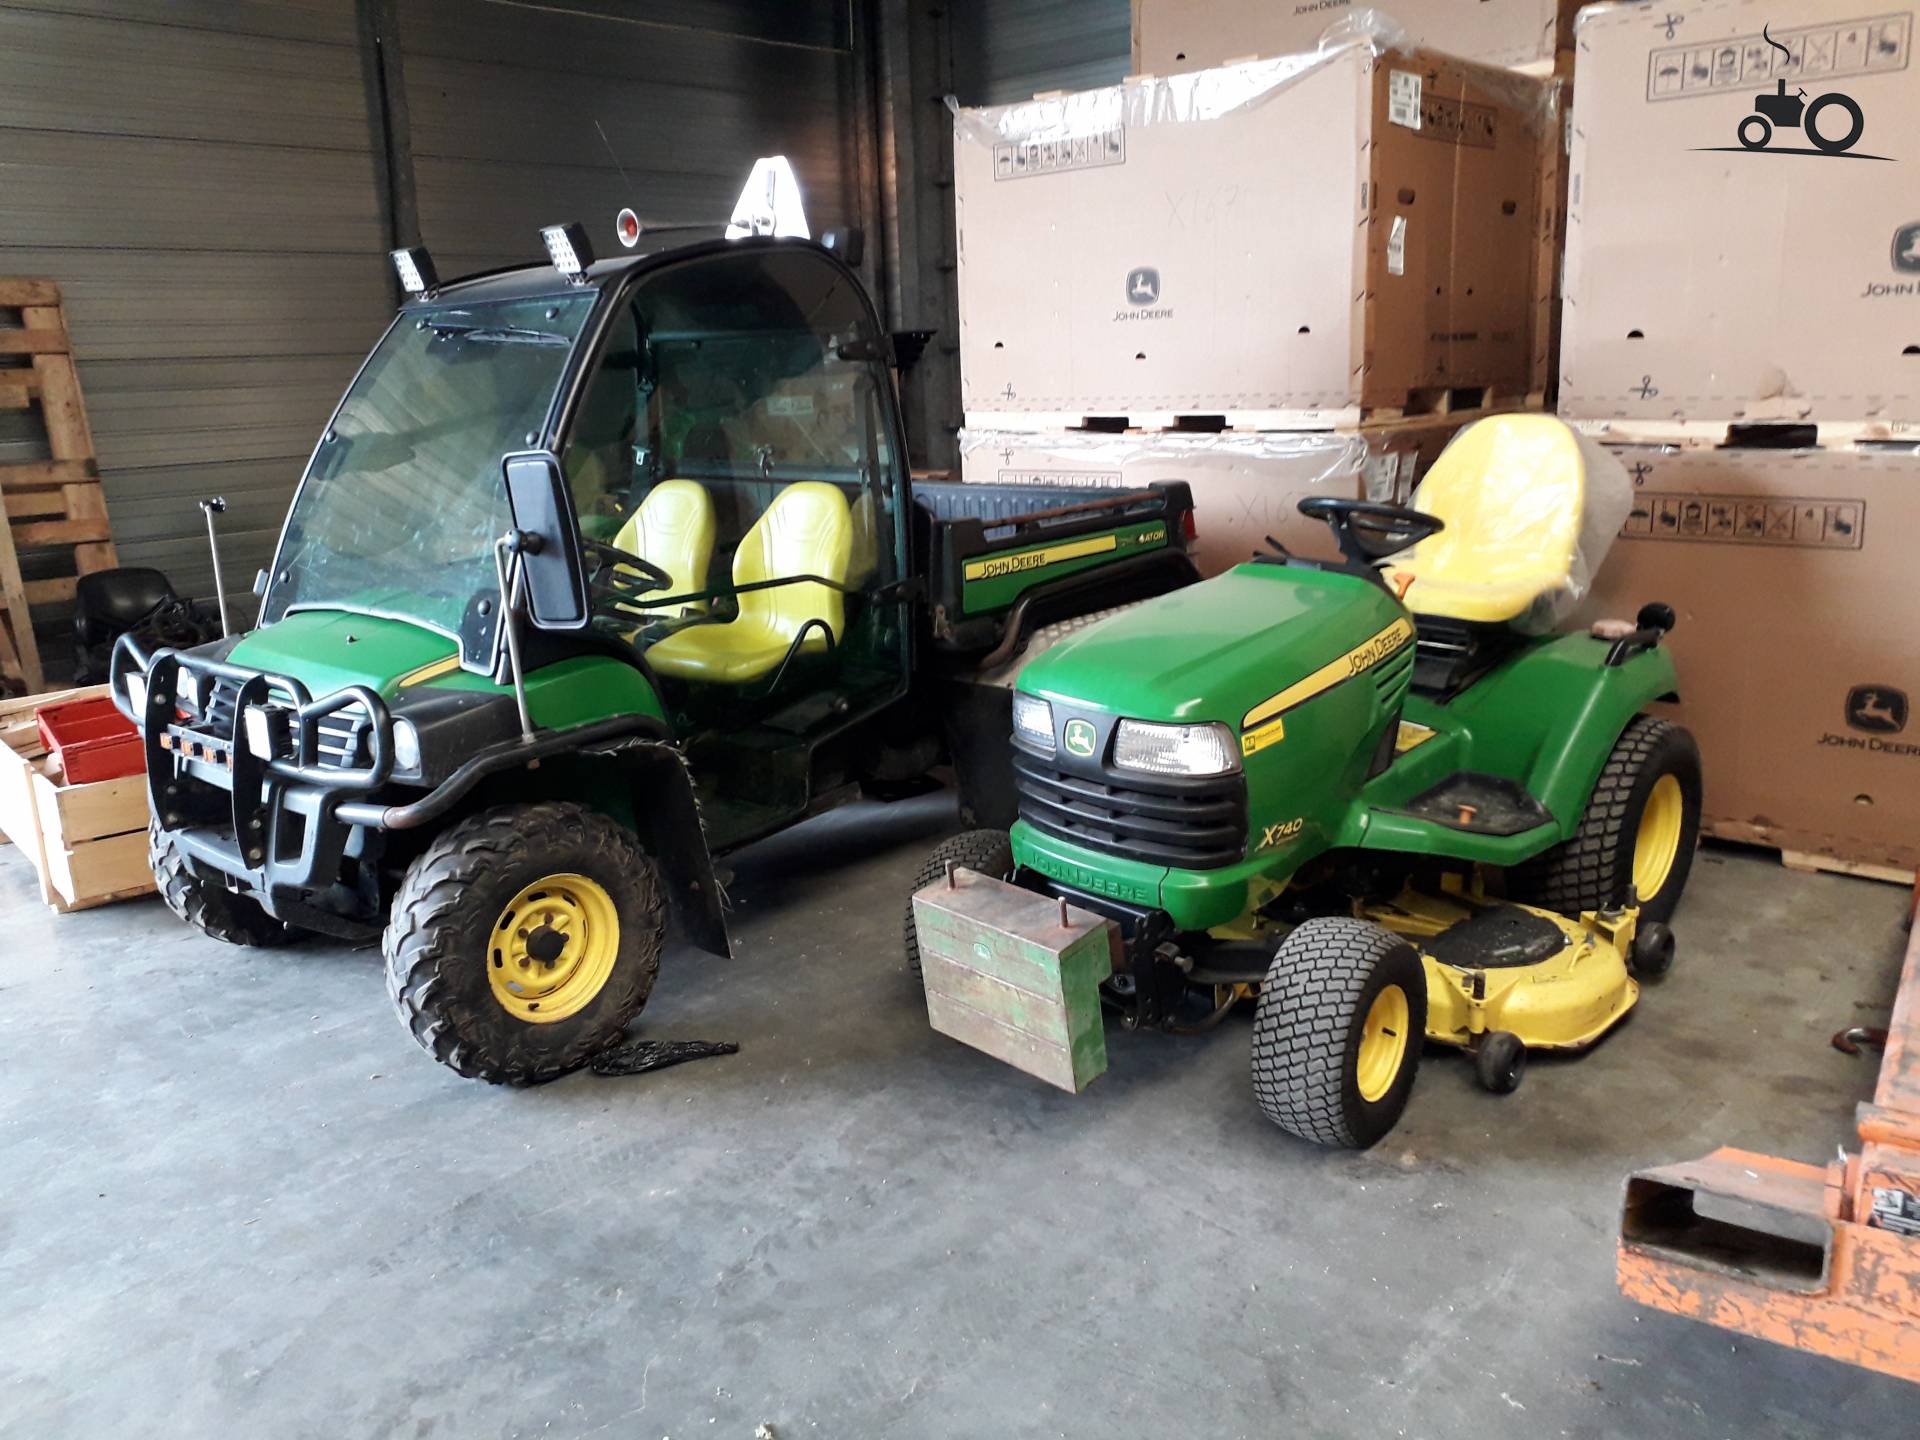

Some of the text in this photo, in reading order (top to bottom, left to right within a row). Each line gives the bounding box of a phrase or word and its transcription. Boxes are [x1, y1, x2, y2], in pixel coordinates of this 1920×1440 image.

[1860, 282, 1913, 298] JOHN
[1112, 308, 1173, 322] JOHN DEERE
[981, 552, 1046, 577] JOHN DEERE
[1348, 627, 1402, 675] JOHN DEERE
[1817, 732, 1920, 756] JOHN DEER
[1255, 817, 1304, 852] X740
[1031, 851, 1148, 903] JOHN DEERE
